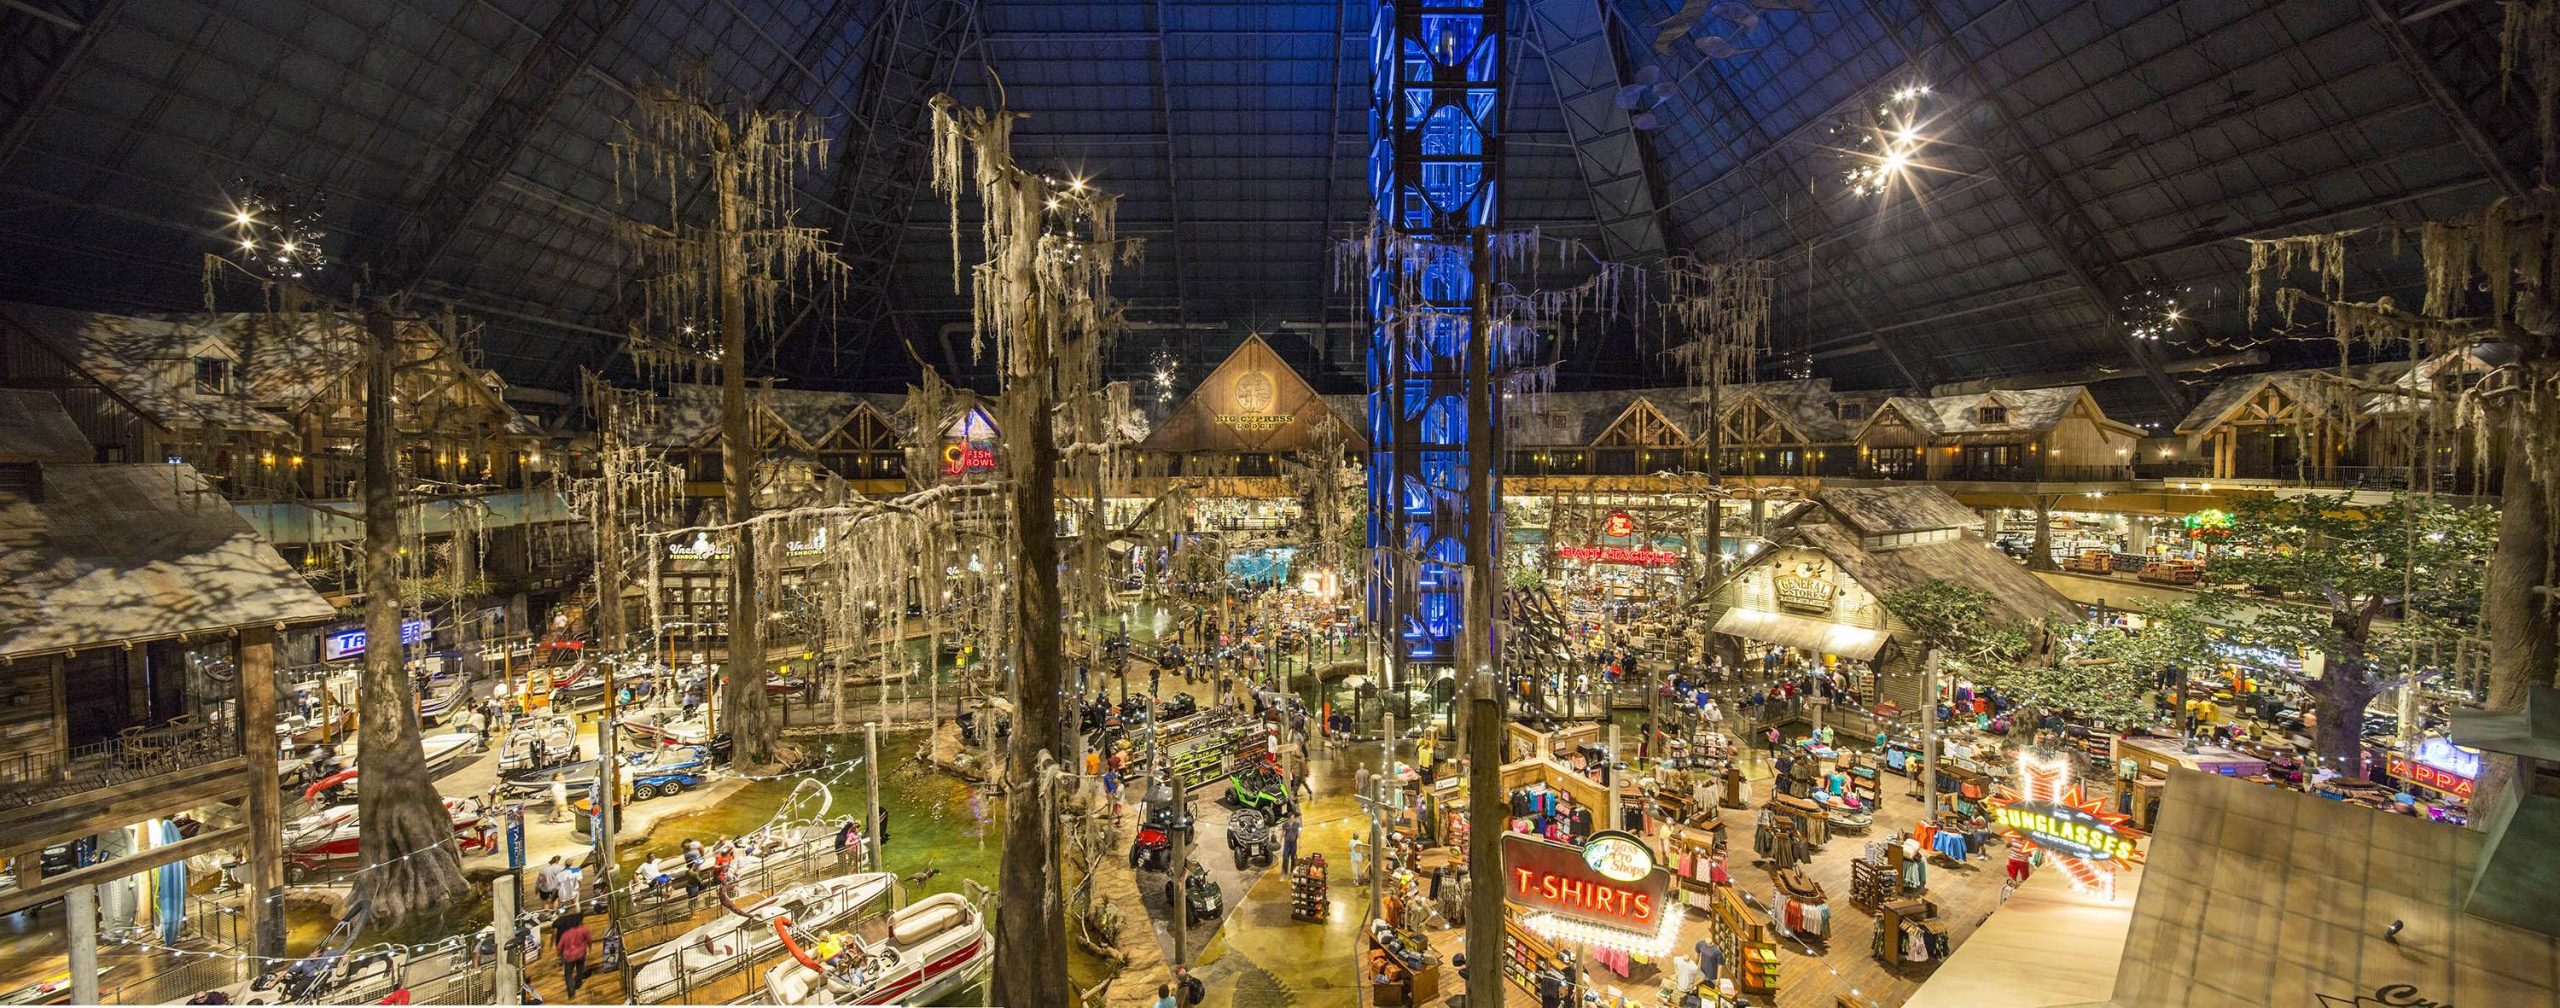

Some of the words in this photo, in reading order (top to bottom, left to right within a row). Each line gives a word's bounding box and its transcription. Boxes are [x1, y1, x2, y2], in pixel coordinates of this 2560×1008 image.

[1216, 415, 1236, 423] BIG
[1240, 415, 1294, 423] CYPRESS
[966, 459, 995, 467] BOWL
[967, 450, 991, 459] FISH
[1561, 546, 1601, 559] BAIT
[1611, 547, 1677, 563] TACKLE
[1780, 577, 1827, 595] GENERAL
[1788, 588, 1821, 599] STORE
[340, 622, 420, 649] TRER
[2391, 760, 2474, 794] APPA
[1995, 807, 2133, 860] SUNGLASSES
[1611, 840, 1639, 854] Bass
[1610, 851, 1633, 863] Pro
[1610, 860, 1646, 877] Shops
[1515, 867, 1650, 920] T-SHIRTS
